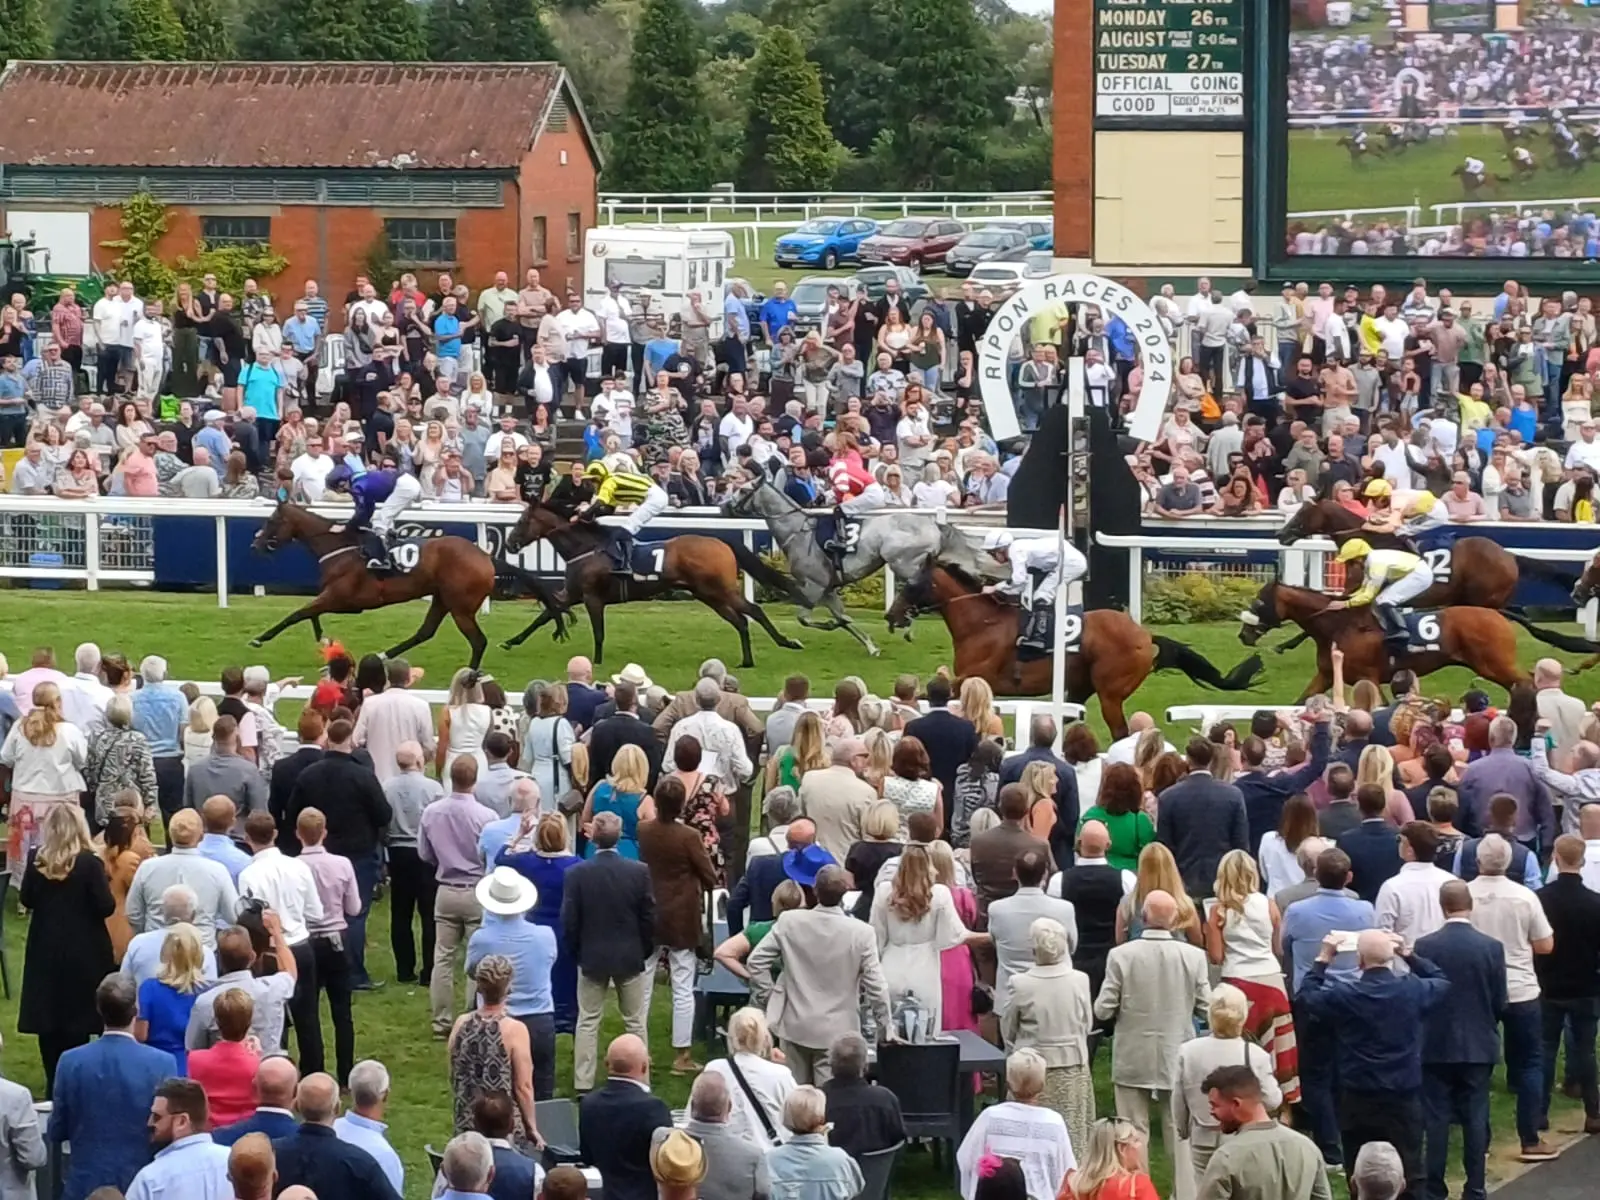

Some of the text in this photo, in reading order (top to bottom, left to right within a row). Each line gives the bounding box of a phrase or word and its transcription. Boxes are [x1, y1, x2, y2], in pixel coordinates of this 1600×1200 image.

[1100, 9, 1166, 26] MONDAY
[1100, 30, 1166, 47] AUGUST
[1098, 53, 1167, 69] TUESDAY
[1102, 76, 1239, 90] OFFICIAL GOING
[1112, 97, 1155, 112] GOOD
[985, 279, 1166, 383] RIPON RACES 2024
[845, 522, 861, 545] 3
[651, 548, 665, 572] 1
[1064, 614, 1082, 643] 9
[1418, 614, 1440, 641] 6
